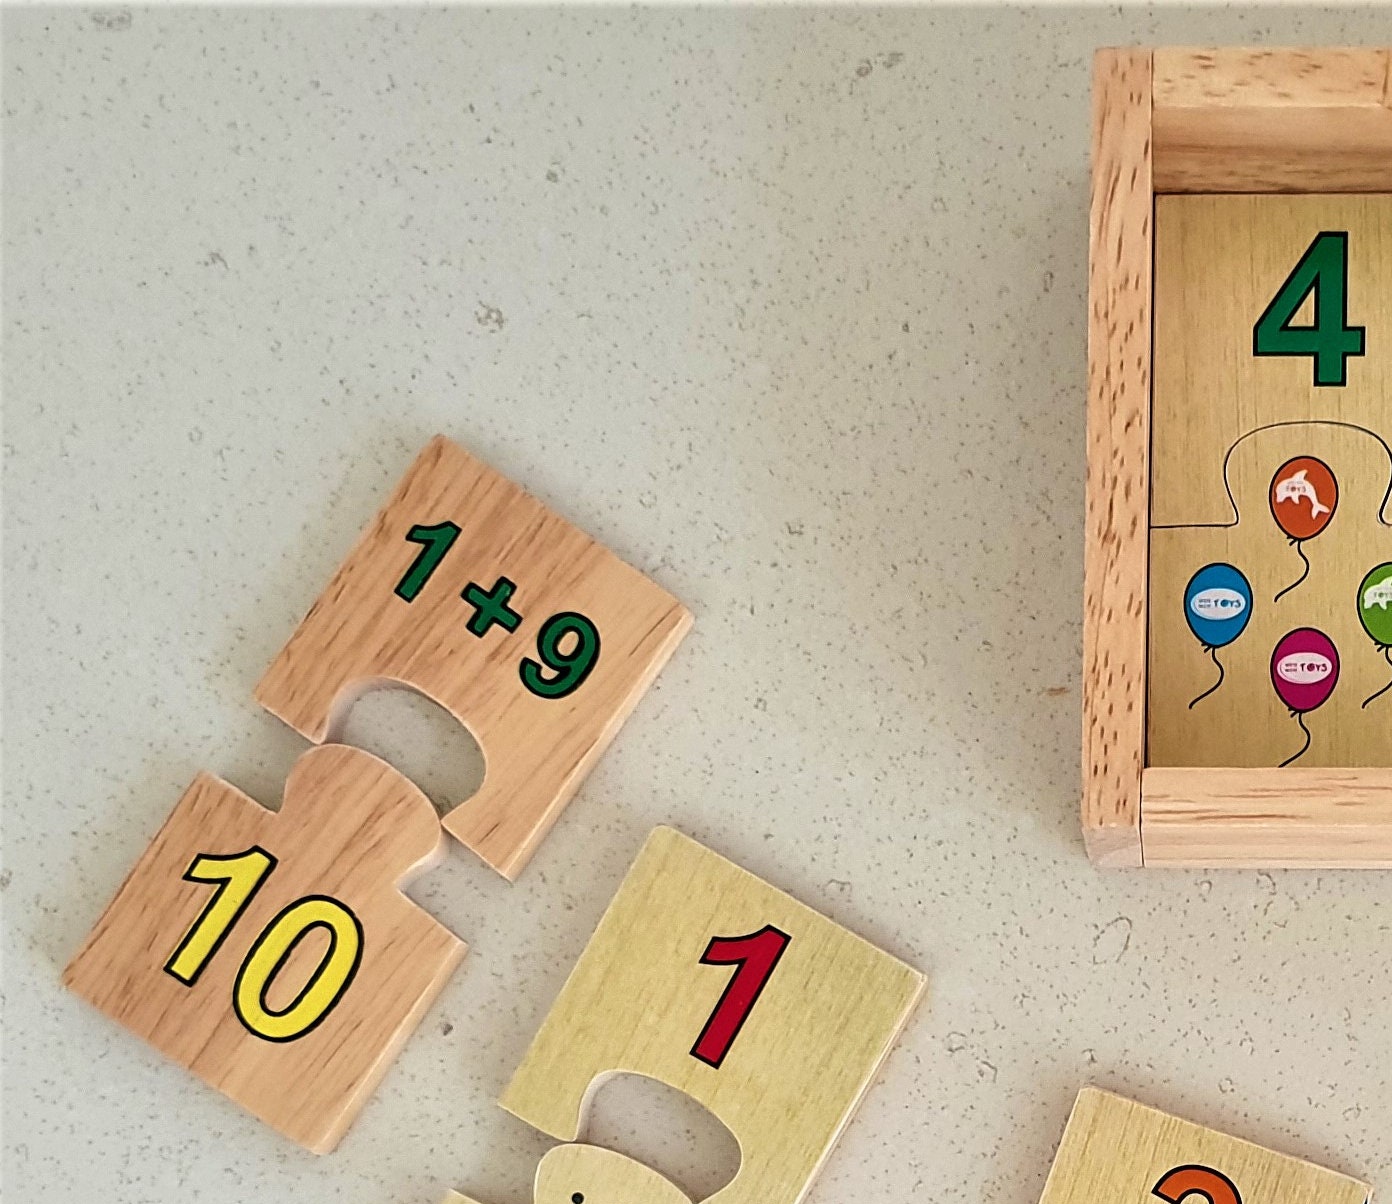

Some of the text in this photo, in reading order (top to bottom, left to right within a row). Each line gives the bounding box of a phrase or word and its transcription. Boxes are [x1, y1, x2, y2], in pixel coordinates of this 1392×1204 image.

[1252, 231, 1366, 387] 4
[1300, 663, 1328, 672] TOYS
[163, 845, 365, 1044] 10
[689, 924, 793, 1069] 1
